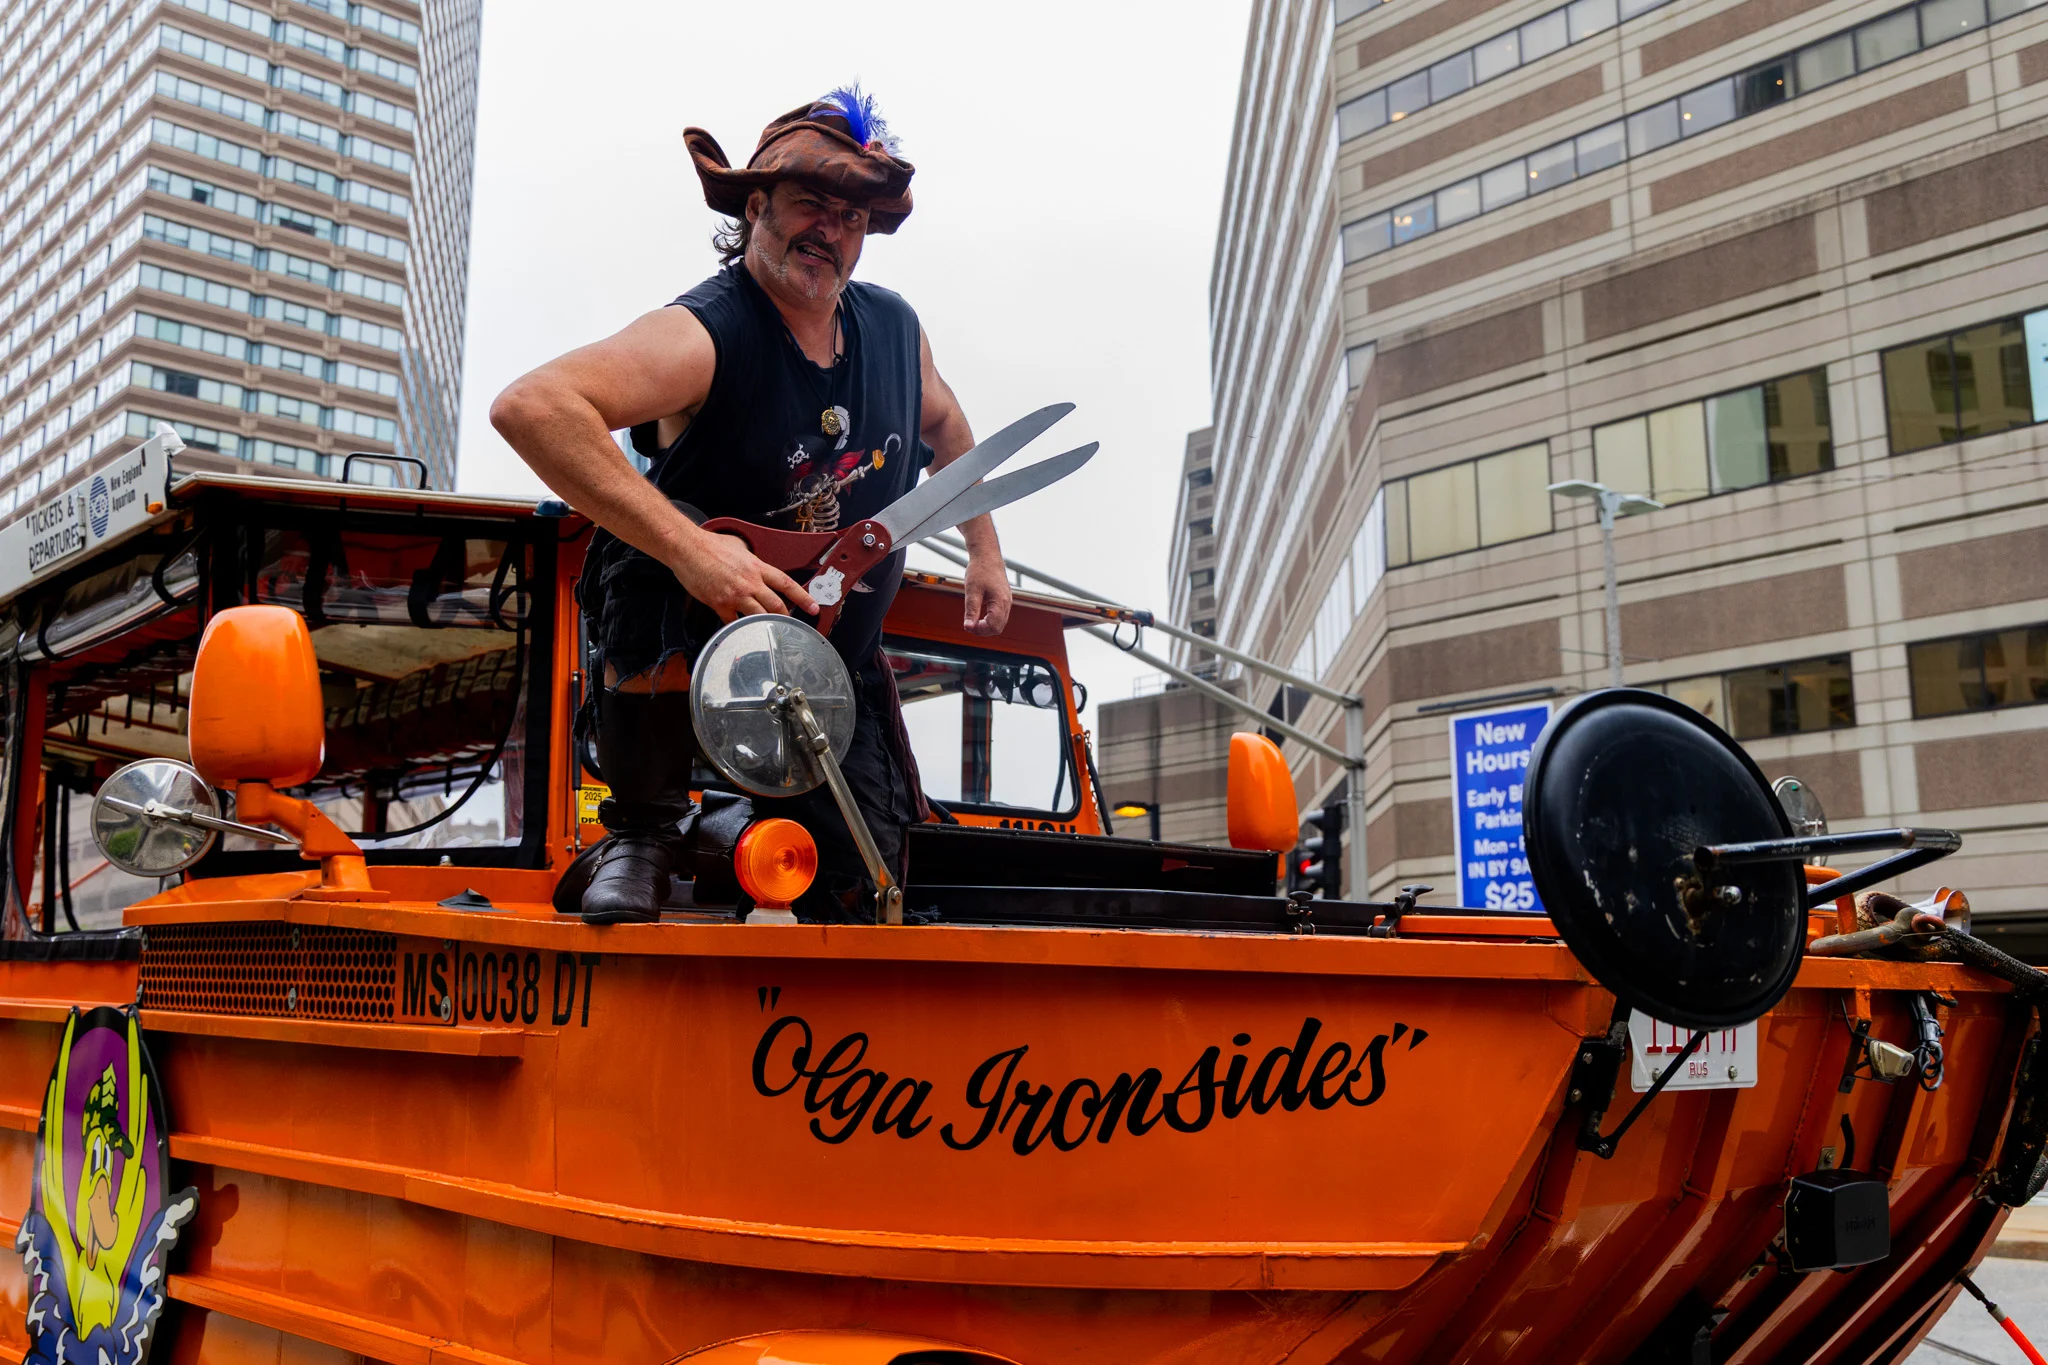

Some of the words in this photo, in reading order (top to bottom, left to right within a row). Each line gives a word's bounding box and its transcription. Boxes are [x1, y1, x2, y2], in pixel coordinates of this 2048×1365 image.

[110, 476, 121, 491] New
[122, 460, 142, 485] England
[112, 489, 136, 512] Aquarium
[31, 500, 63, 536] TICKETS
[67, 495, 75, 518] &
[29, 522, 80, 570] DEPARTURES
[1475, 721, 1526, 747] New
[584, 791, 603, 801] 2025
[1466, 786, 1508, 808] Early
[1475, 808, 1523, 830] Parkin
[1474, 838, 1508, 856] Mon
[1467, 860, 1487, 879] IN
[1487, 858, 1509, 877] BY
[1510, 855, 1532, 876] 9A
[1485, 880, 1535, 910] $25
[402, 952, 449, 1017] MS
[461, 952, 541, 1025] 0038
[552, 952, 601, 1028] DT
[1689, 1061, 1709, 1076] BUS
